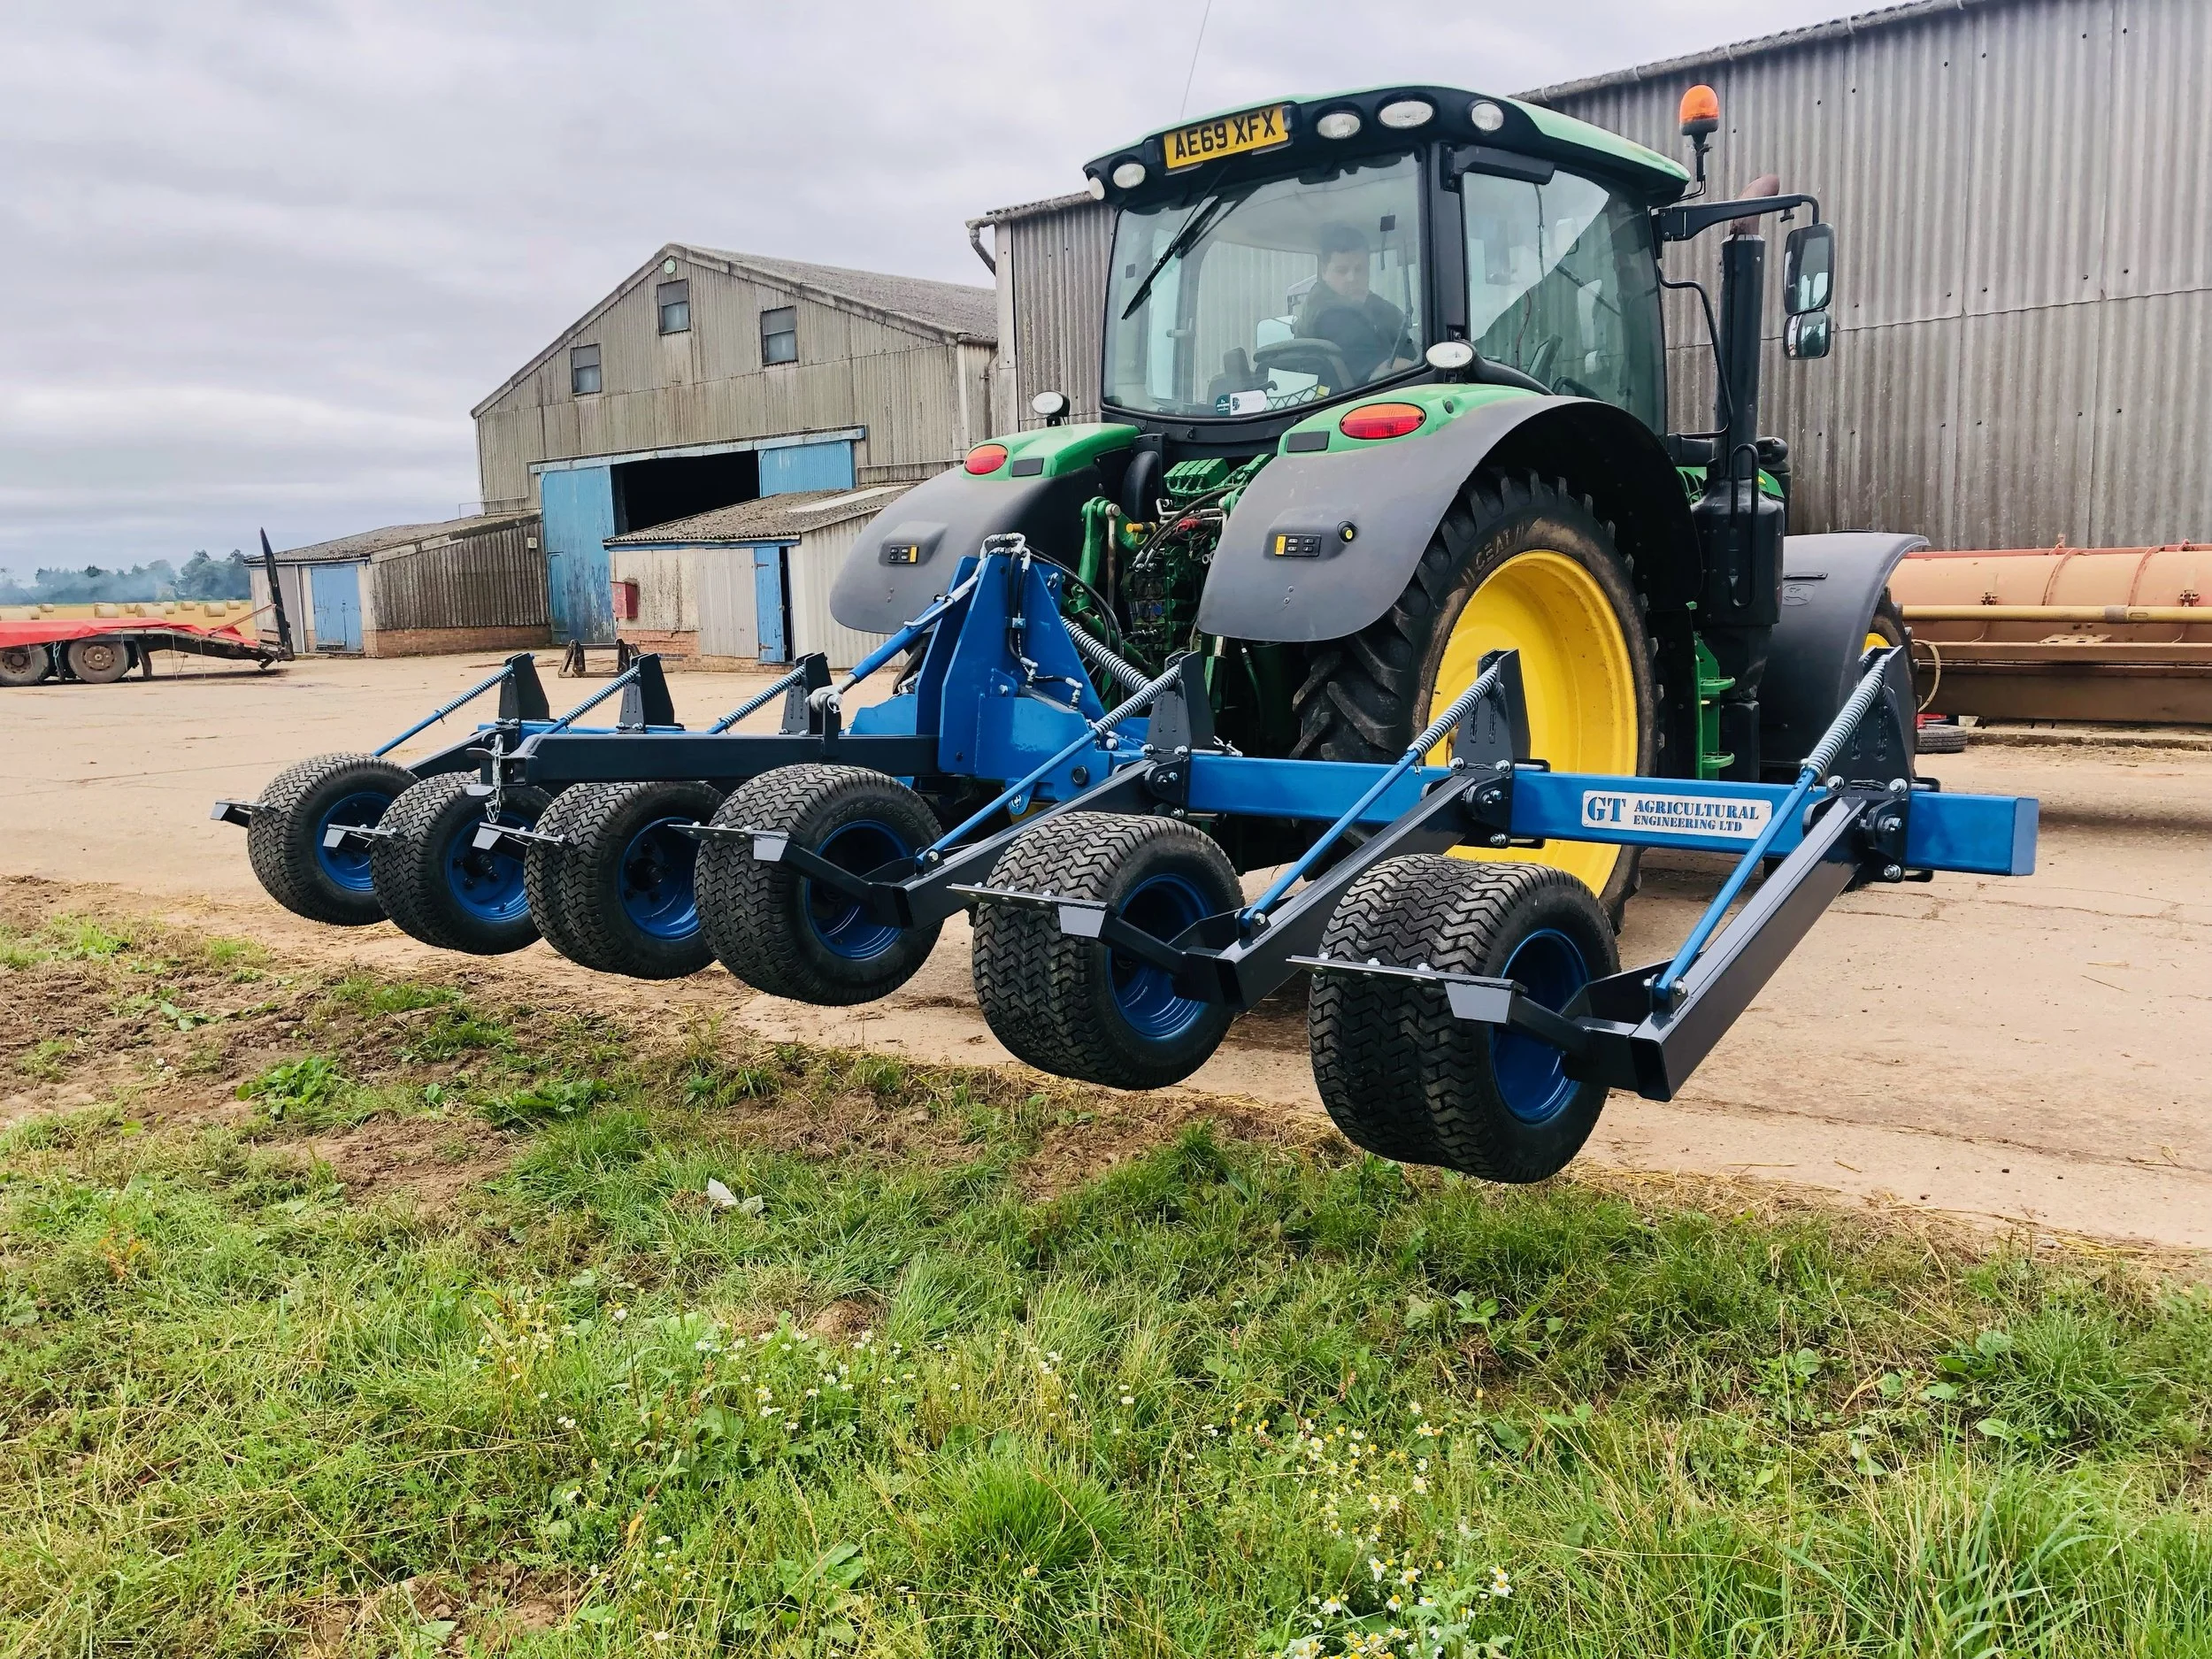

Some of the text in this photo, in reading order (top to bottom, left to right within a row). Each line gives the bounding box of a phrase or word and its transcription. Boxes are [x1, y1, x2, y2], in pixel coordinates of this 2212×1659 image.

[1175, 109, 1277, 160] AE69 XFX
[1474, 527, 1510, 572] CEAT
[1586, 796, 1626, 822] GT
[1633, 799, 1759, 819] AGRICULTURAL
[1633, 815, 1743, 832] ENGINEERING LTD
